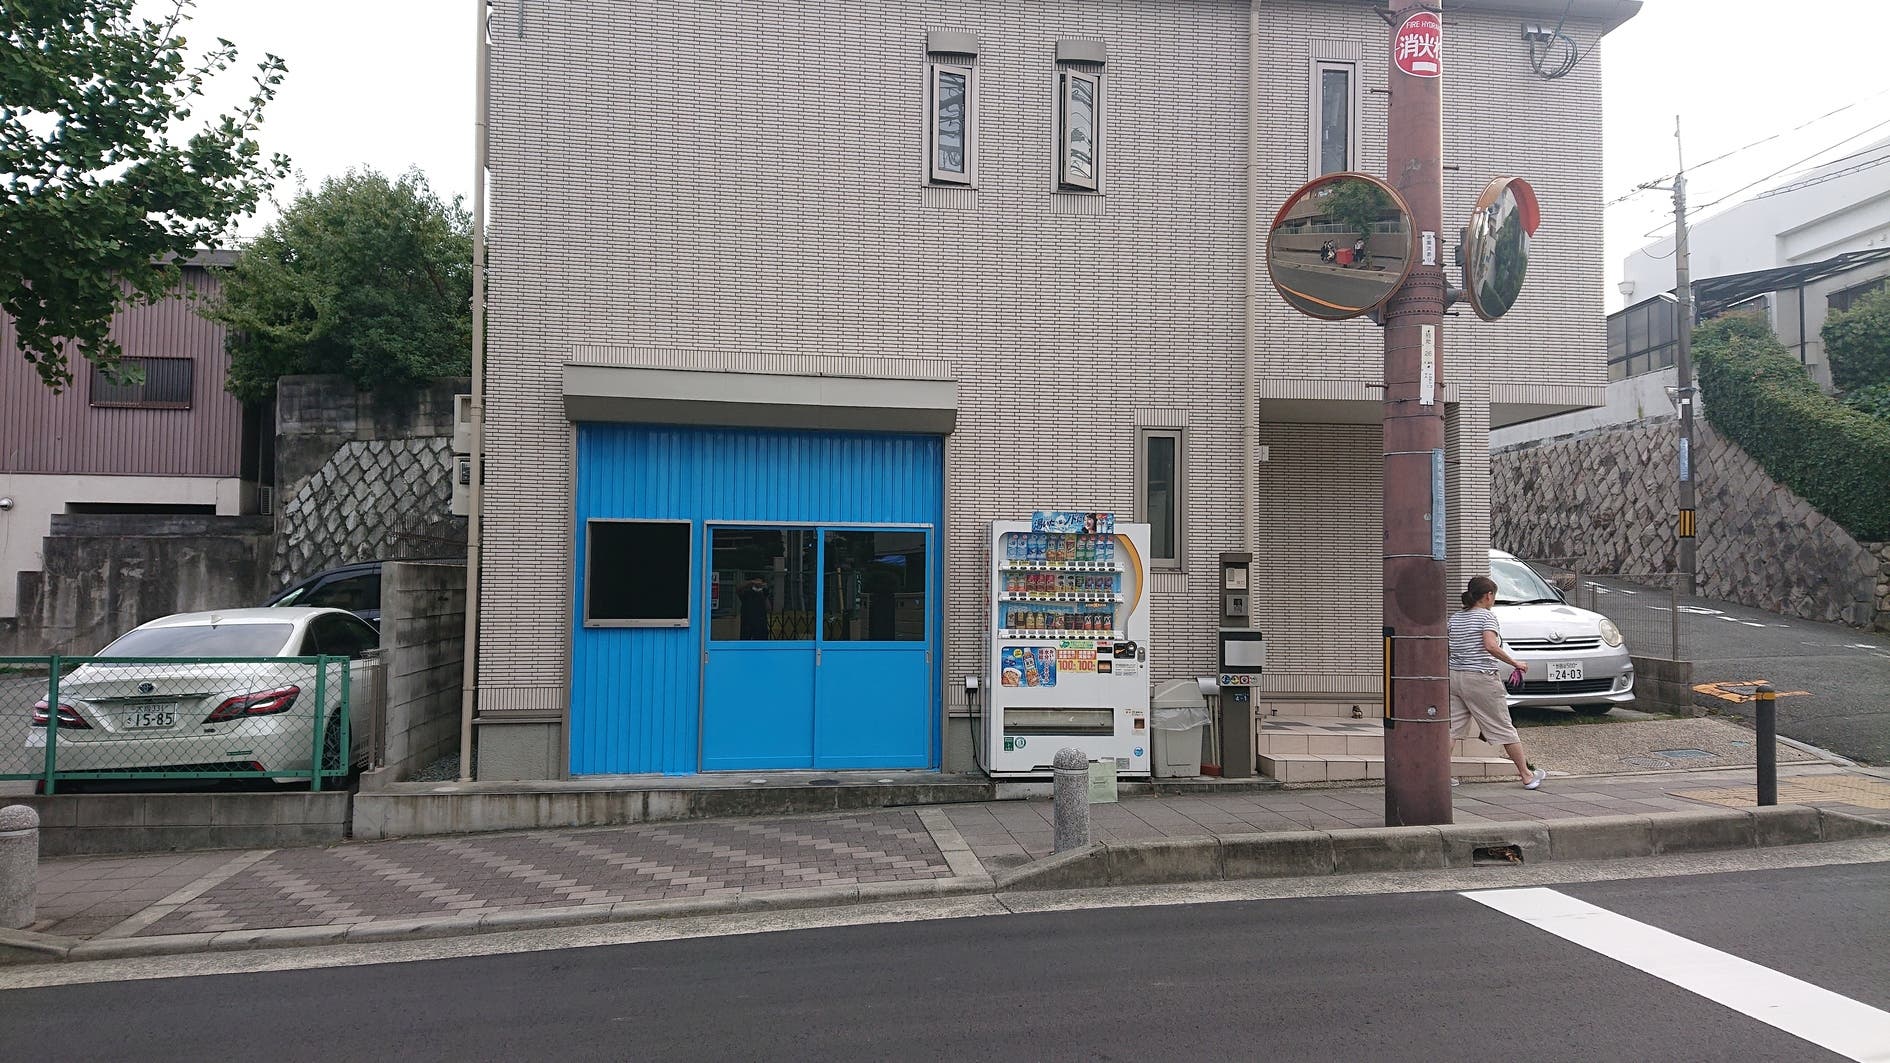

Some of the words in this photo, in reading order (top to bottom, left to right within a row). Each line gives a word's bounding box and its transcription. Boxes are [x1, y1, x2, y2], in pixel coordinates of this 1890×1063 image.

[1406, 20, 1420, 29] FIRE
[1555, 669, 1582, 680] 24-03
[136, 713, 172, 726] 15-85
